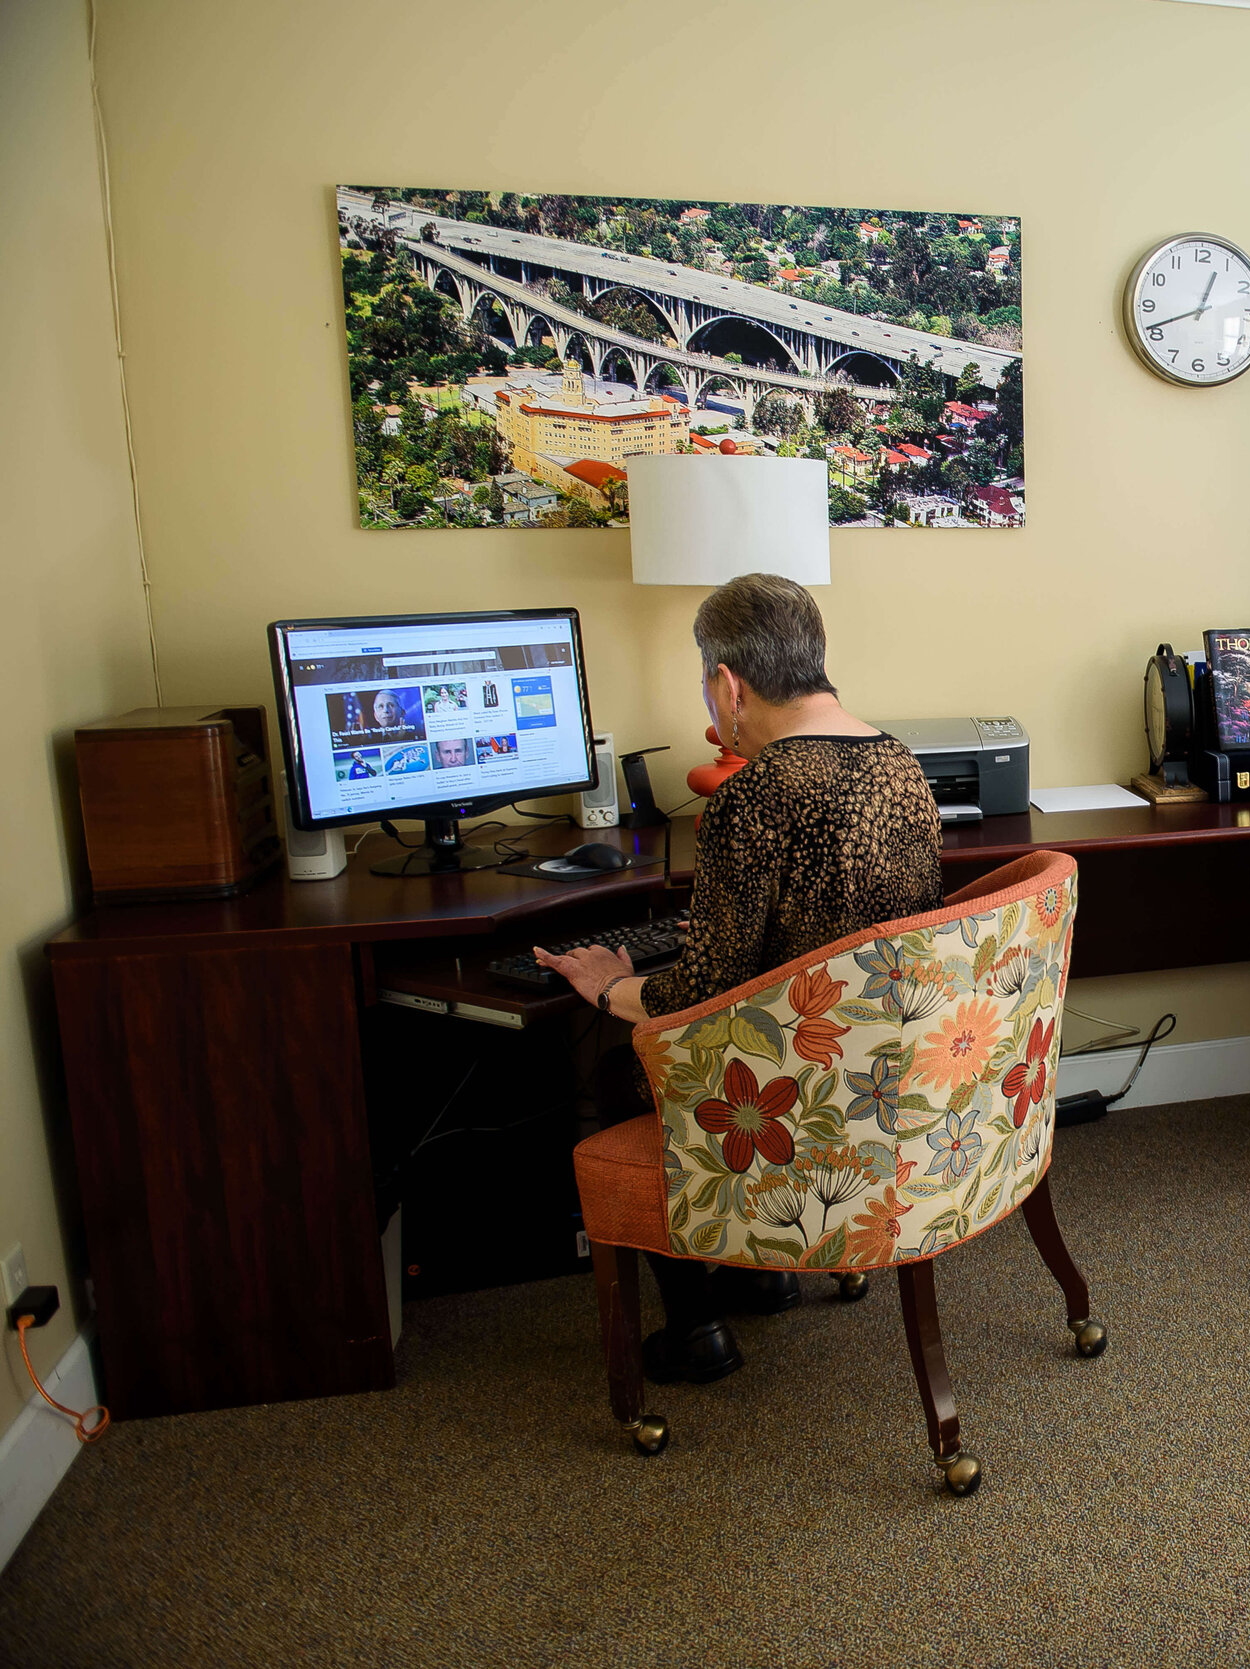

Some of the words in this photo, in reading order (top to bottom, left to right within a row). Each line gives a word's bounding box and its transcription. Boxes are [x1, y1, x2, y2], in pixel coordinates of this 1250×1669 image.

[1195, 249, 1211, 263] 12
[1172, 256, 1180, 270] 11
[1226, 258, 1229, 271] 1
[1152, 273, 1165, 286] 10
[1237, 281, 1250, 294] 2
[1142, 300, 1155, 312] 9
[1150, 327, 1164, 340] 8
[1237, 335, 1248, 347] 4
[1168, 350, 1179, 363] 7
[1217, 353, 1230, 366] 5
[1192, 359, 1204, 372] 6
